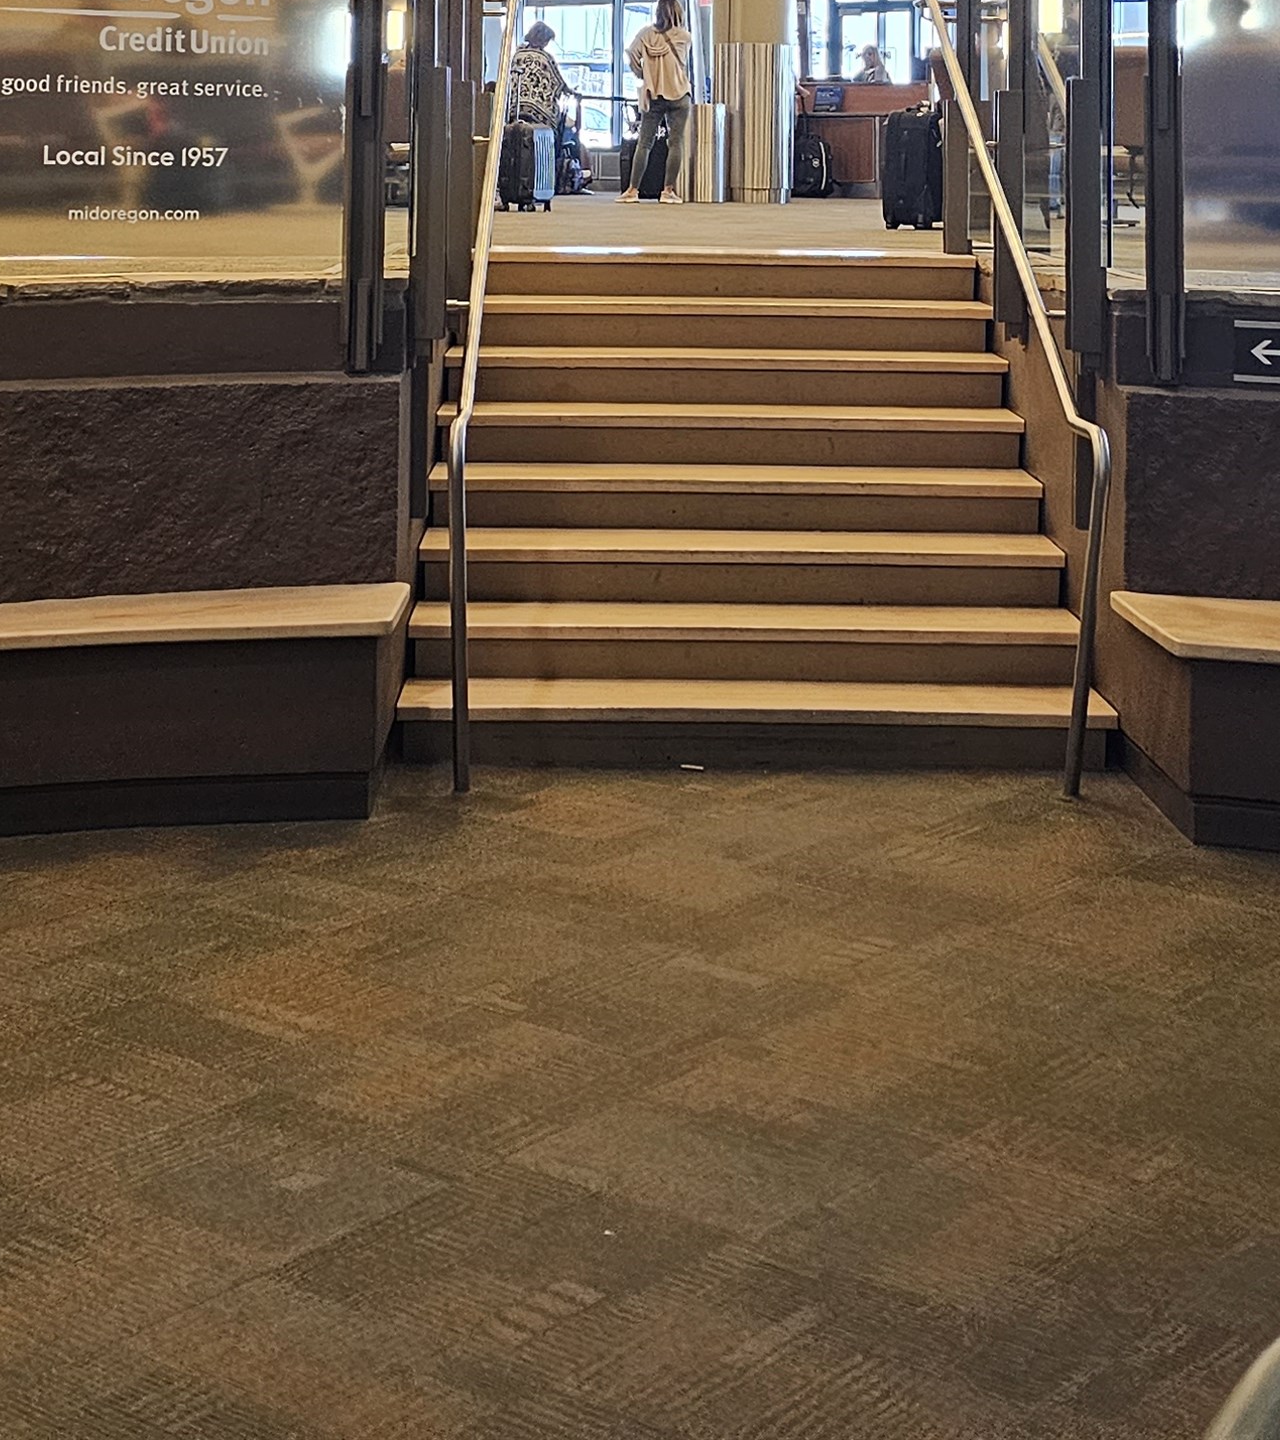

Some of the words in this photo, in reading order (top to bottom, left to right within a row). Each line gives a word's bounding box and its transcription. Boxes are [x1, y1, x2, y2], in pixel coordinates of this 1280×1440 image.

[99, 25, 185, 53] Credit
[190, 29, 269, 56] Union
[1, 74, 50, 96] good
[56, 74, 133, 95] friends.
[136, 79, 189, 99] great
[193, 80, 269, 98] service.
[43, 145, 106, 166] Local
[111, 146, 174, 167] Since
[181, 147, 229, 168] 1957
[68, 206, 199, 224] midoregon.com
